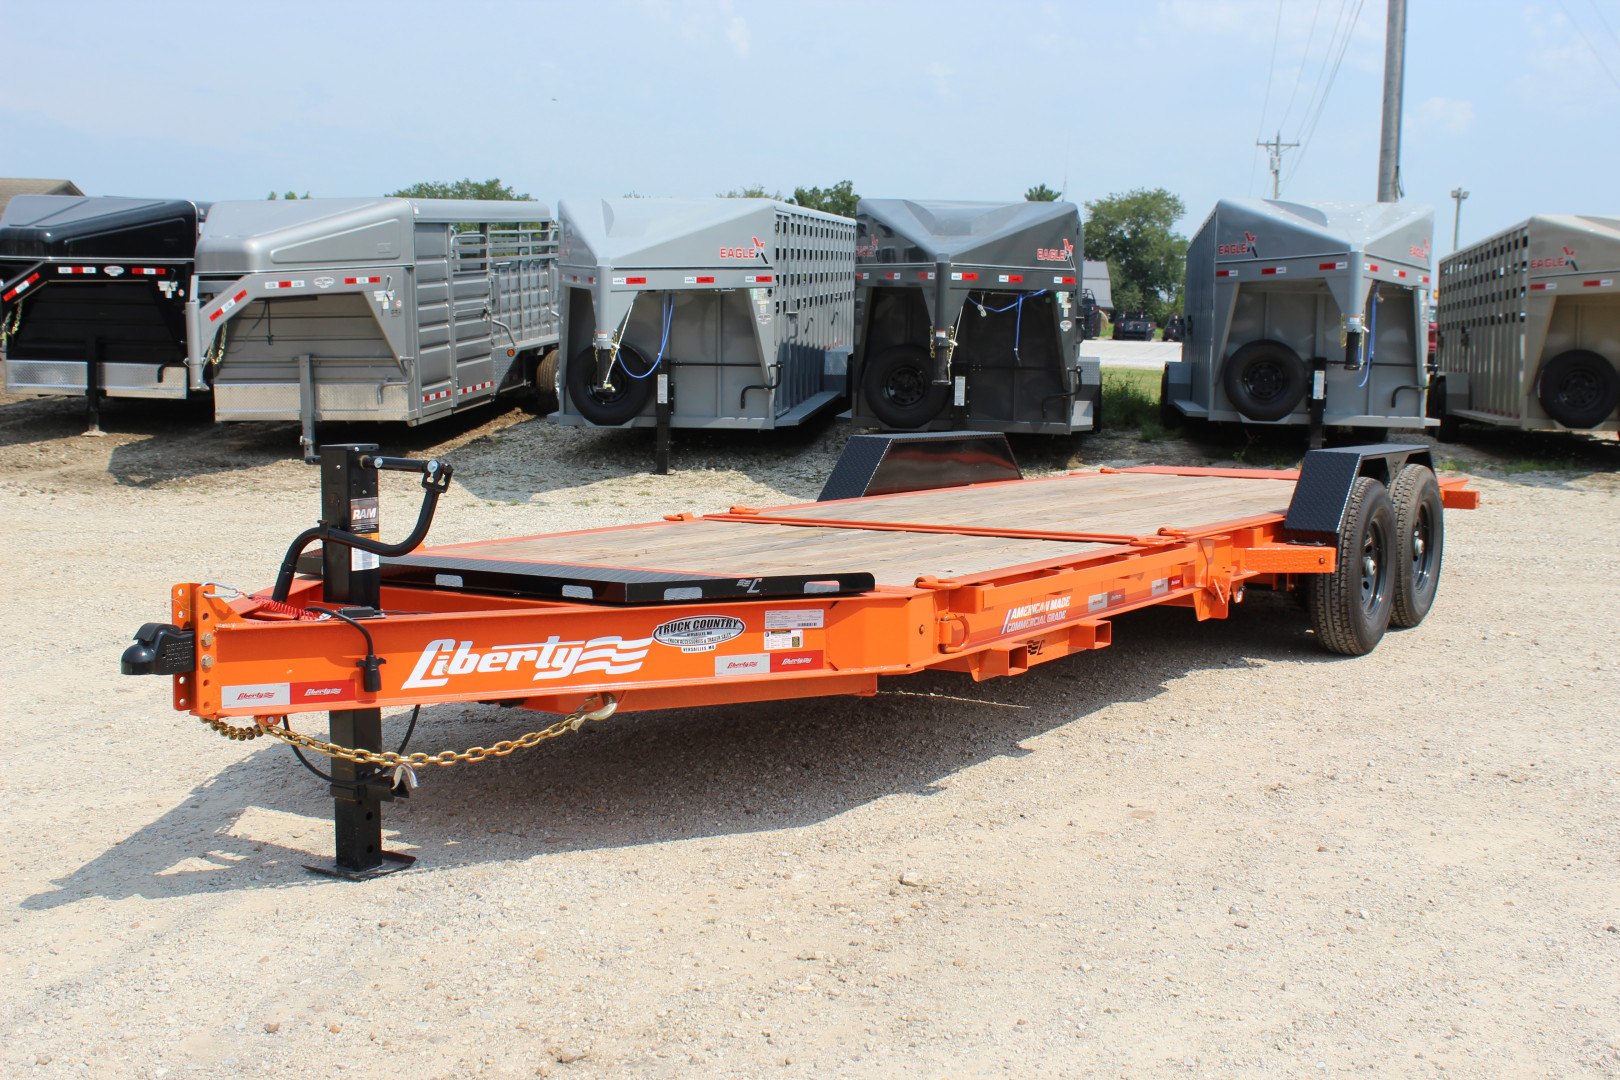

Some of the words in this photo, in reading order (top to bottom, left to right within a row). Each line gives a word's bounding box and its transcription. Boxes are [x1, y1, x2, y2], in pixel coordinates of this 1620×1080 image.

[720, 248, 755, 259] EAGLE
[1037, 248, 1066, 261] EAGLE
[1218, 243, 1247, 255] EAGLE
[1531, 257, 1565, 269] EAGLE
[352, 507, 376, 521] RAM
[1011, 599, 1050, 619] AMERICAN
[1050, 596, 1071, 611] MADE
[658, 620, 690, 635] TRUCK
[693, 618, 740, 630] COUNTRY
[1006, 615, 1047, 633] COMMERCIAL
[1047, 610, 1067, 624] GRADE
[400, 635, 585, 690] Liberty
[237, 690, 264, 700] Liberty
[303, 687, 331, 697] Liberty
